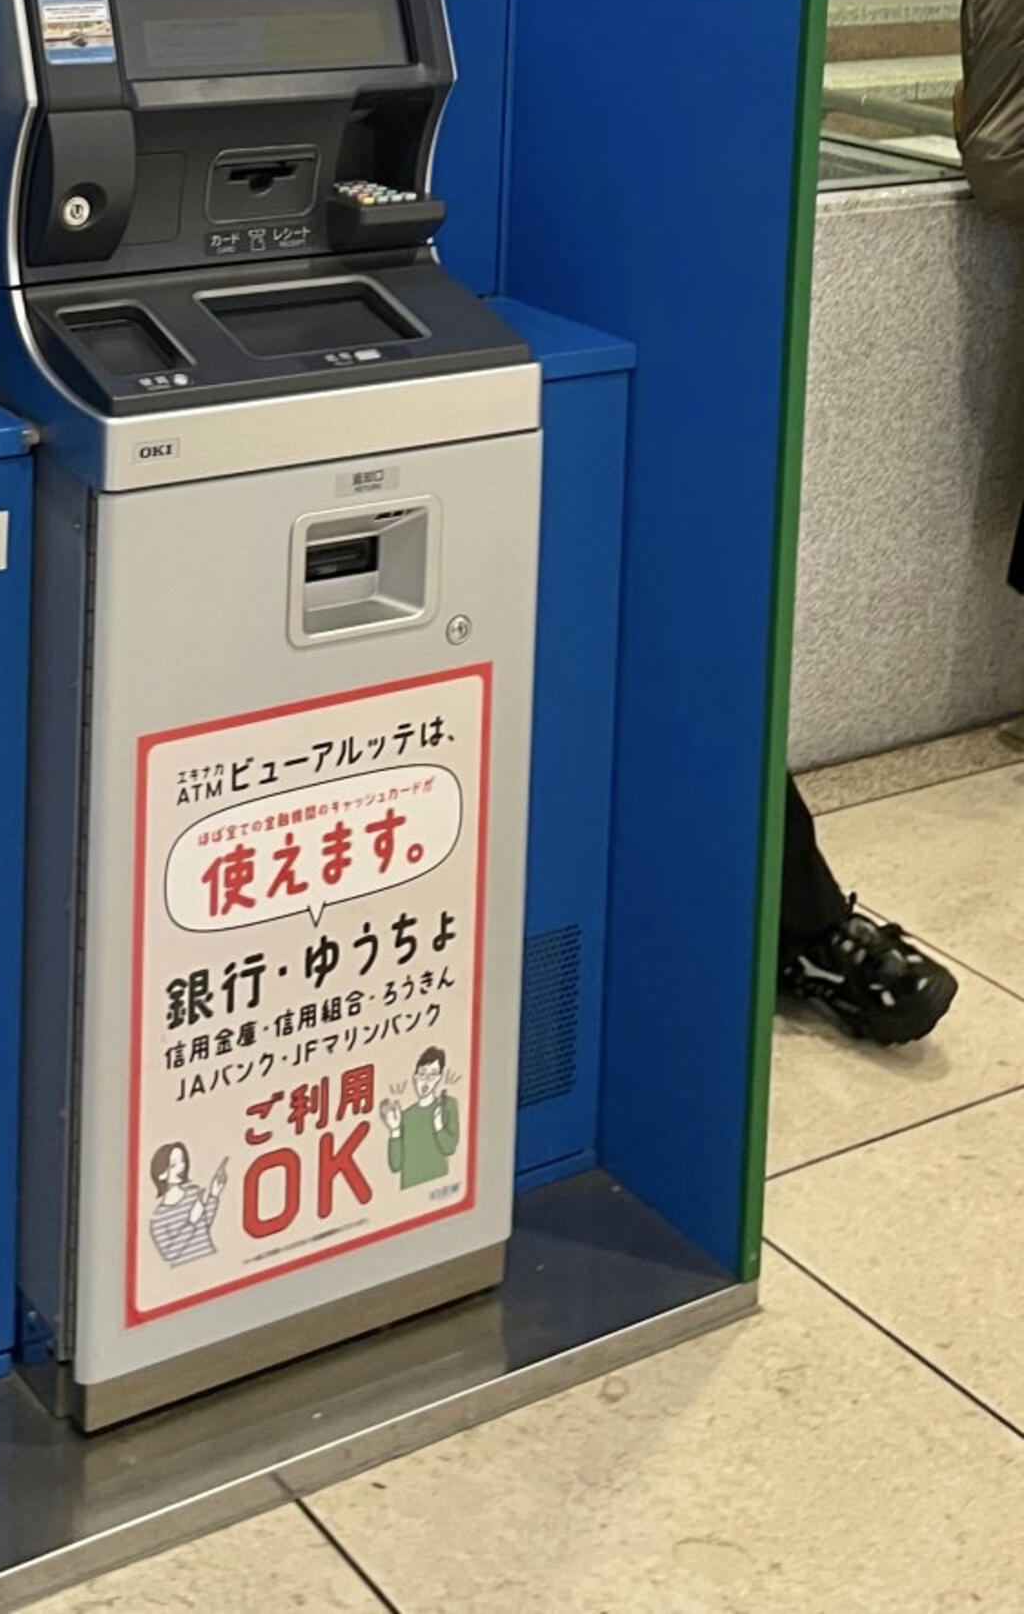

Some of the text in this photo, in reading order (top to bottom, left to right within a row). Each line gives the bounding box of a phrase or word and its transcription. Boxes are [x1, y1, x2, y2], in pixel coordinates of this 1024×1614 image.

[211, 227, 311, 246] カード レシート
[139, 443, 172, 459] OKI
[176, 716, 455, 806] ATM ビューアルッテは、
[177, 763, 225, 785] エキナカ
[198, 776, 436, 846] ほぼ全ての金融機関のキャッシュカードが
[202, 808, 424, 917] 使えます。
[165, 910, 456, 1030] 銀行・ゆうちょ
[165, 967, 456, 1070] 信用金庫・信用組合・ろうきん
[177, 1003, 441, 1101] JAバンク・JFマリンバンク
[245, 1063, 376, 1146] ご利用
[242, 1120, 374, 1239] OK
